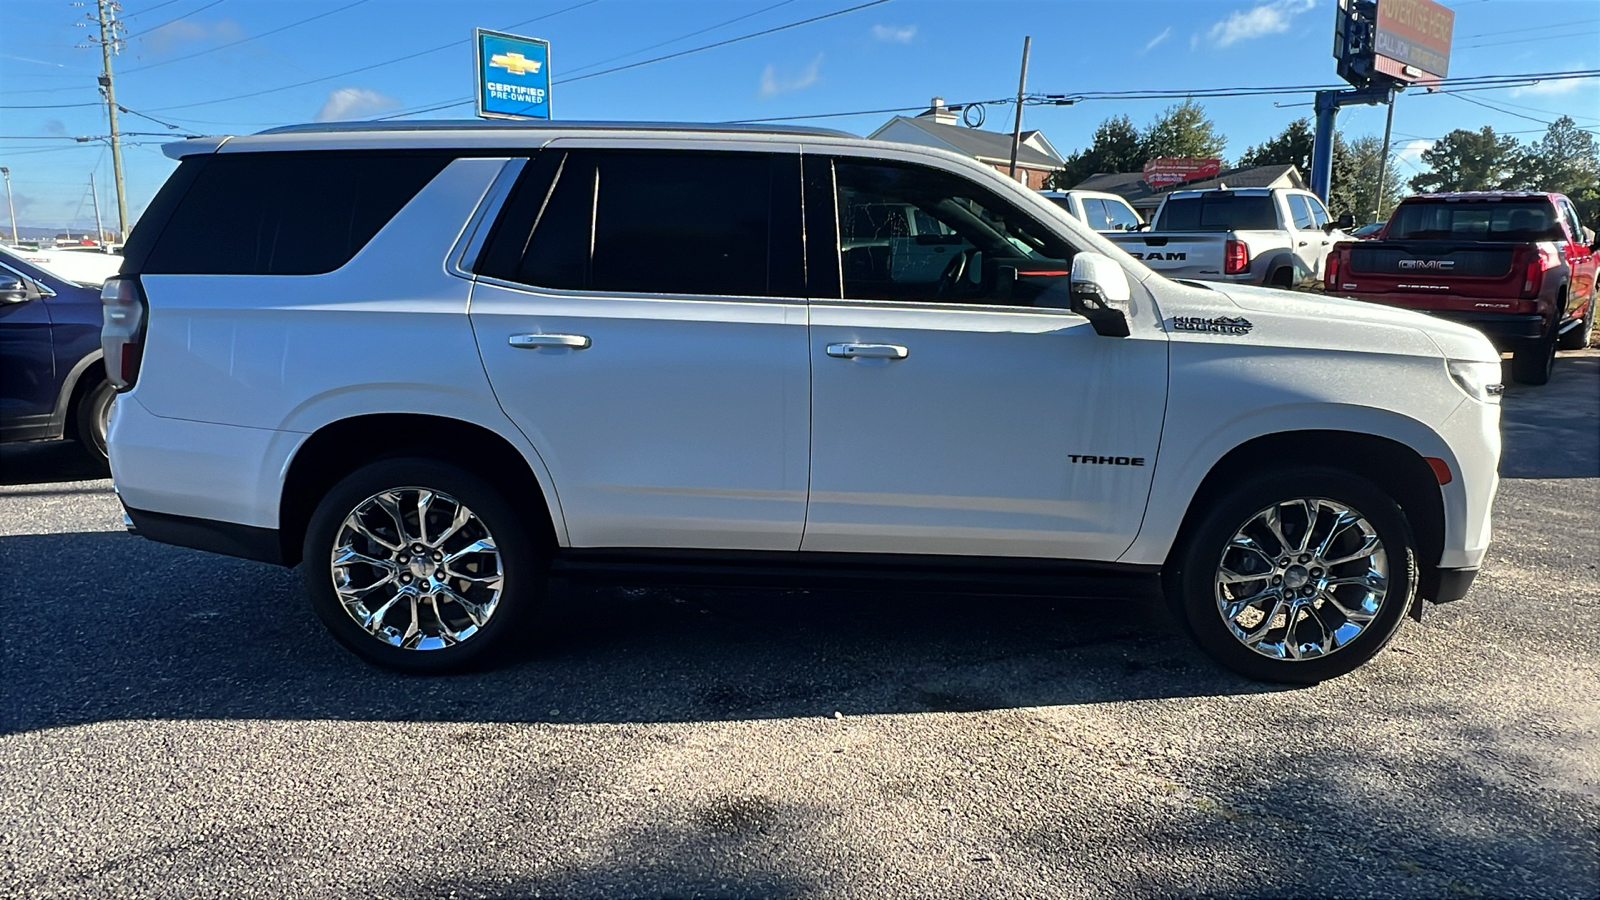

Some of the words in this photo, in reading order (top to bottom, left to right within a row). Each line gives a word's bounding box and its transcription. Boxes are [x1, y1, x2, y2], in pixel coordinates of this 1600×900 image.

[1380, 0, 1428, 34] ADVERTISE
[1427, 10, 1452, 43] HERE
[1378, 32, 1395, 53] CALL
[487, 82, 545, 97] CERTIFIED
[490, 91, 543, 104] PRE-OWNED
[1130, 252, 1187, 261] RAM
[1398, 259, 1455, 269] GMC
[1173, 315, 1213, 324] HIGH
[1173, 322, 1250, 334] COUNTRY
[1067, 454, 1145, 466] TAHOE
